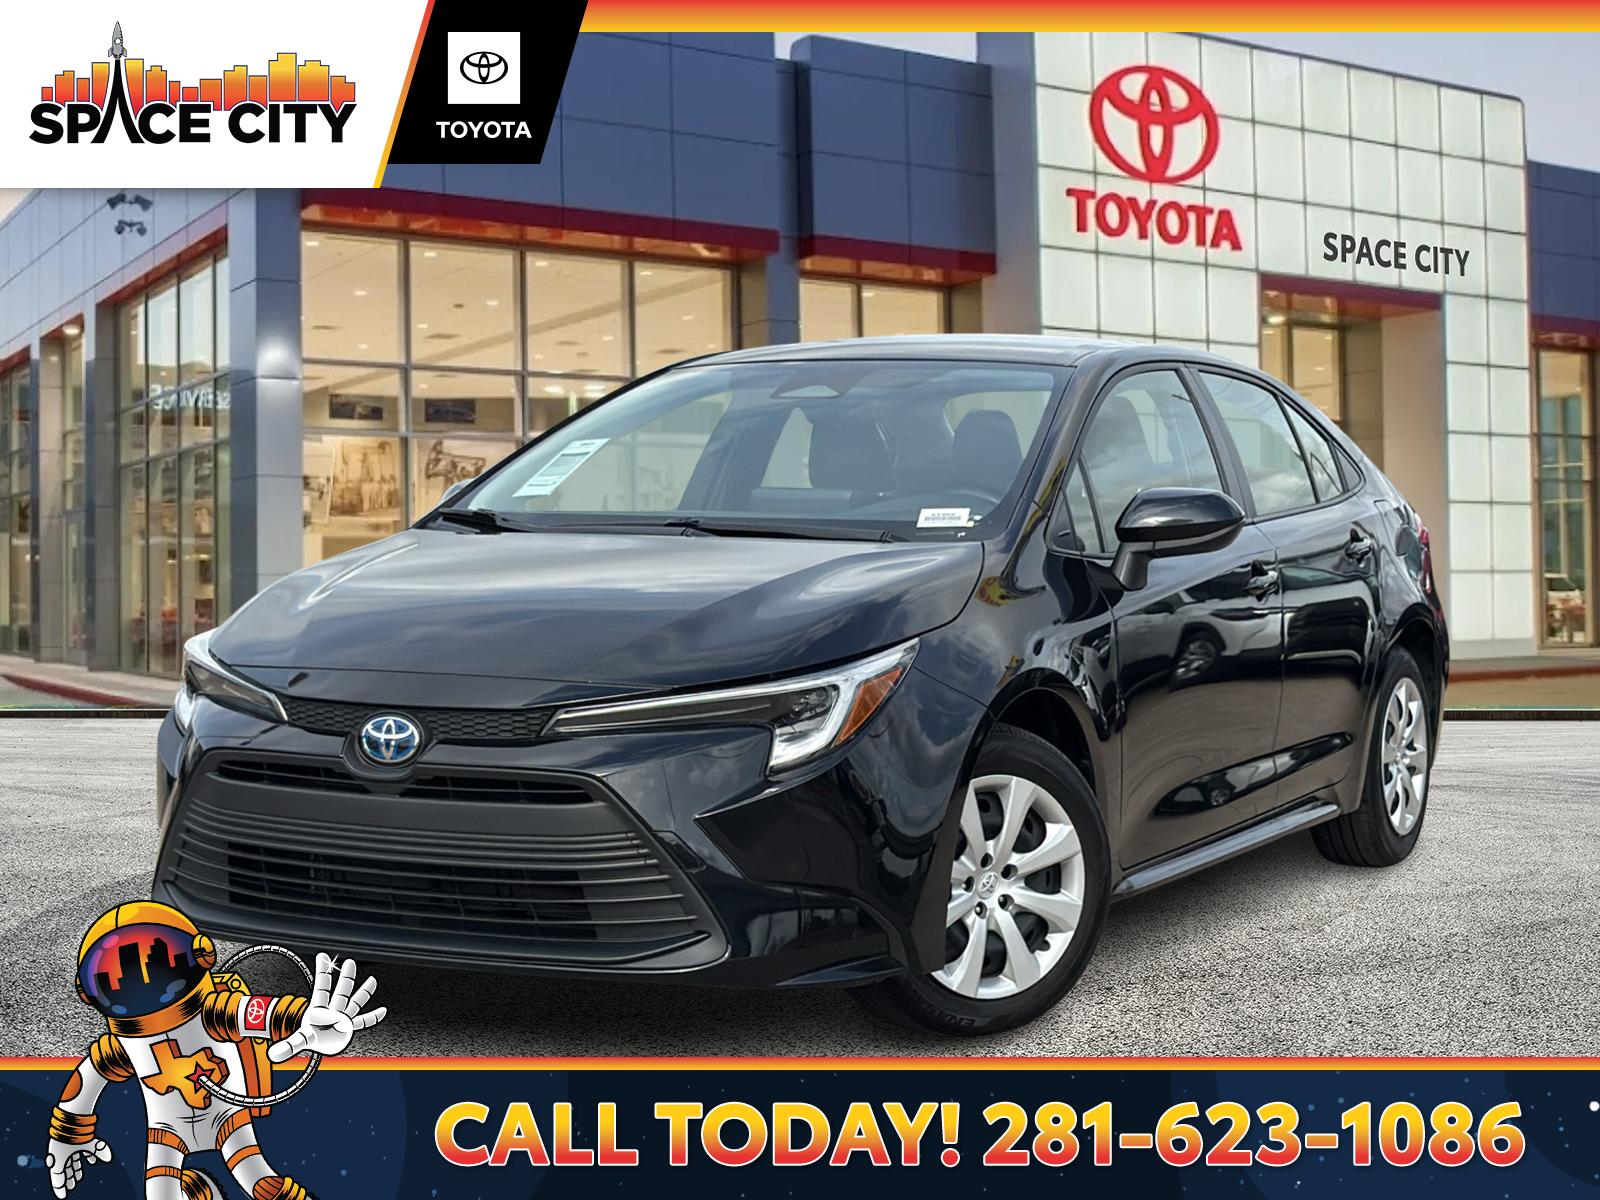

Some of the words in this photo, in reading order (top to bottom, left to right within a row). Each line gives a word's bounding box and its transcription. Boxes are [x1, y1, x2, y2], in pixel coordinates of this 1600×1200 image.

[1066, 187, 1242, 251] TOYOTA
[1323, 232, 1407, 270] SPACE
[1414, 244, 1470, 277] CITY
